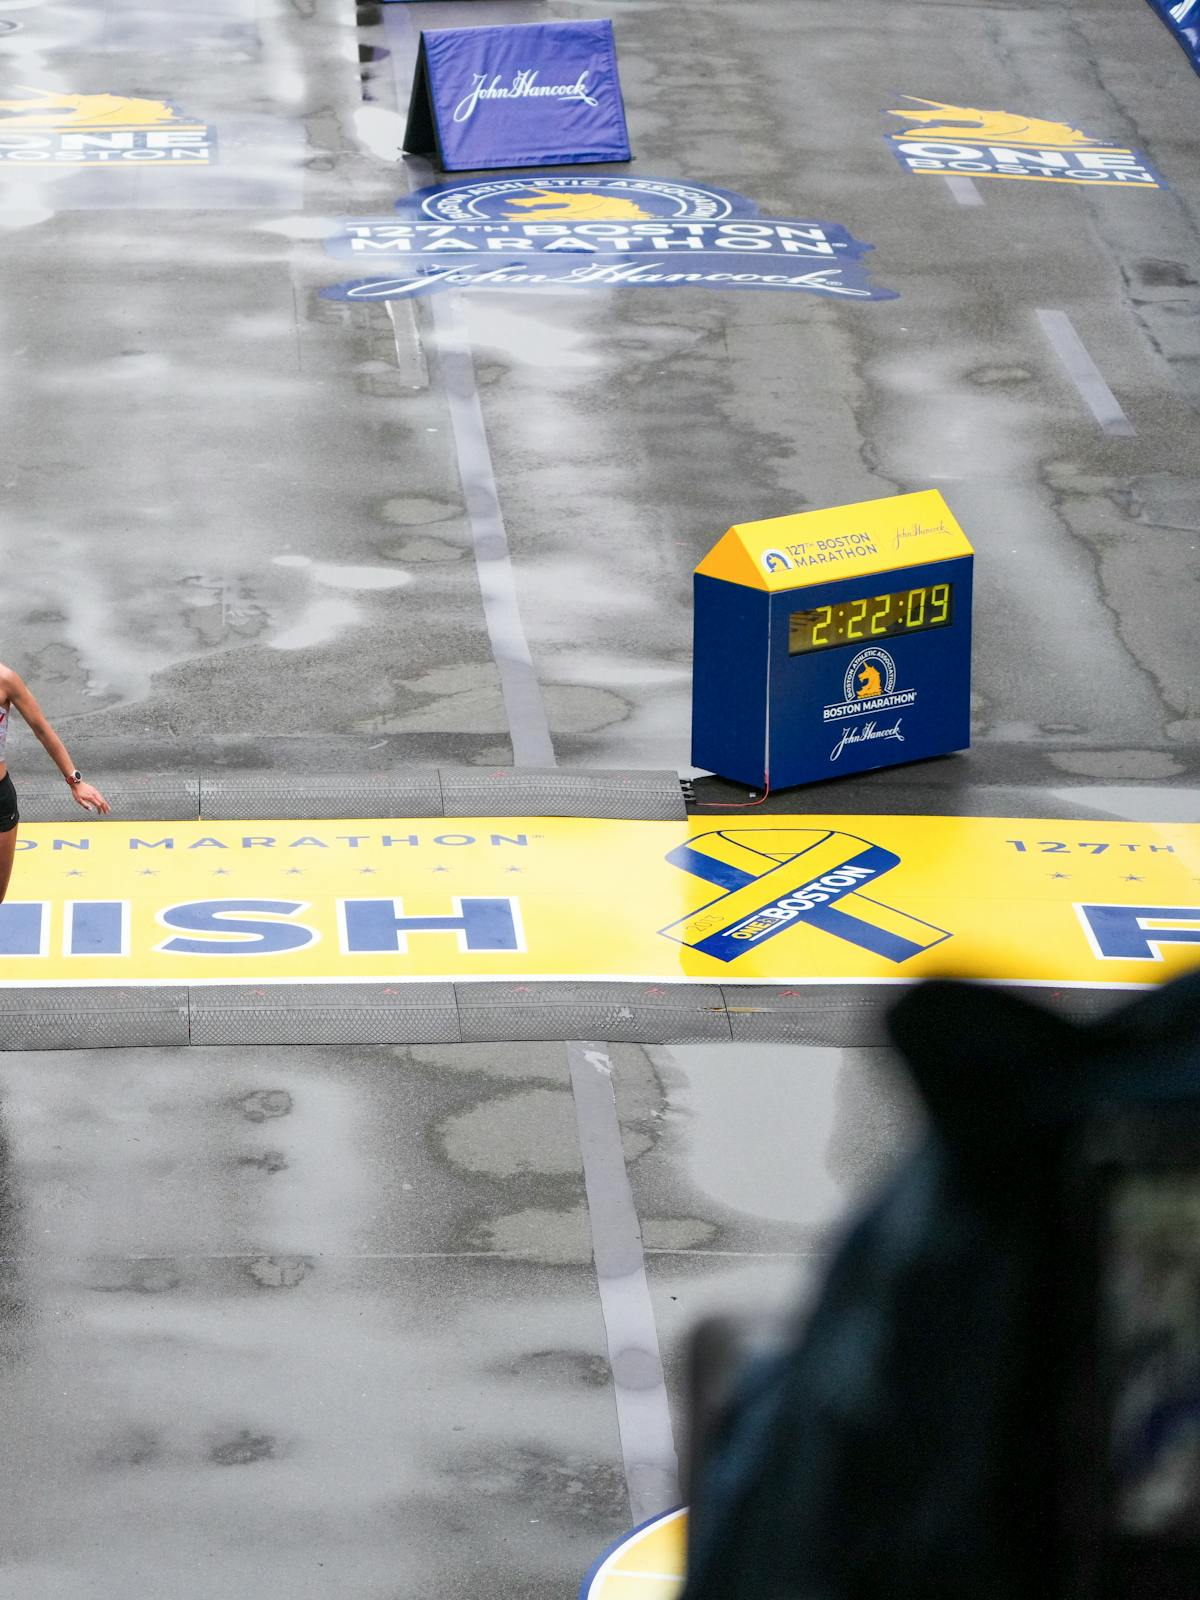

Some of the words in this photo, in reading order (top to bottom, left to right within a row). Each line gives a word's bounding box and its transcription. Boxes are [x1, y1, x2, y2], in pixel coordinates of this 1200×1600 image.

[453, 73, 508, 123] John
[507, 69, 599, 107] Hancock
[897, 142, 1146, 171] ONE
[905, 158, 1156, 182] BOSTON
[467, 179, 599, 196] ATHLETIC
[346, 225, 510, 237] 127TH
[523, 223, 827, 240] BOSTON
[351, 236, 835, 254] MARATHON
[347, 263, 547, 296] John
[548, 262, 871, 296] Hancock
[816, 532, 871, 551] BOSTON
[794, 543, 878, 568] MARATHON
[812, 583, 950, 645] 2:22:09
[852, 650, 878, 669] ATHLETIC
[823, 703, 861, 719] BOSTON
[862, 692, 915, 712] MARATHON
[830, 726, 860, 761] John
[859, 718, 905, 742] Hancock
[128, 834, 529, 849] MARATHON
[1005, 840, 1175, 855] 127TH
[730, 917, 770, 940] ONE
[765, 865, 877, 920] BOSTON
